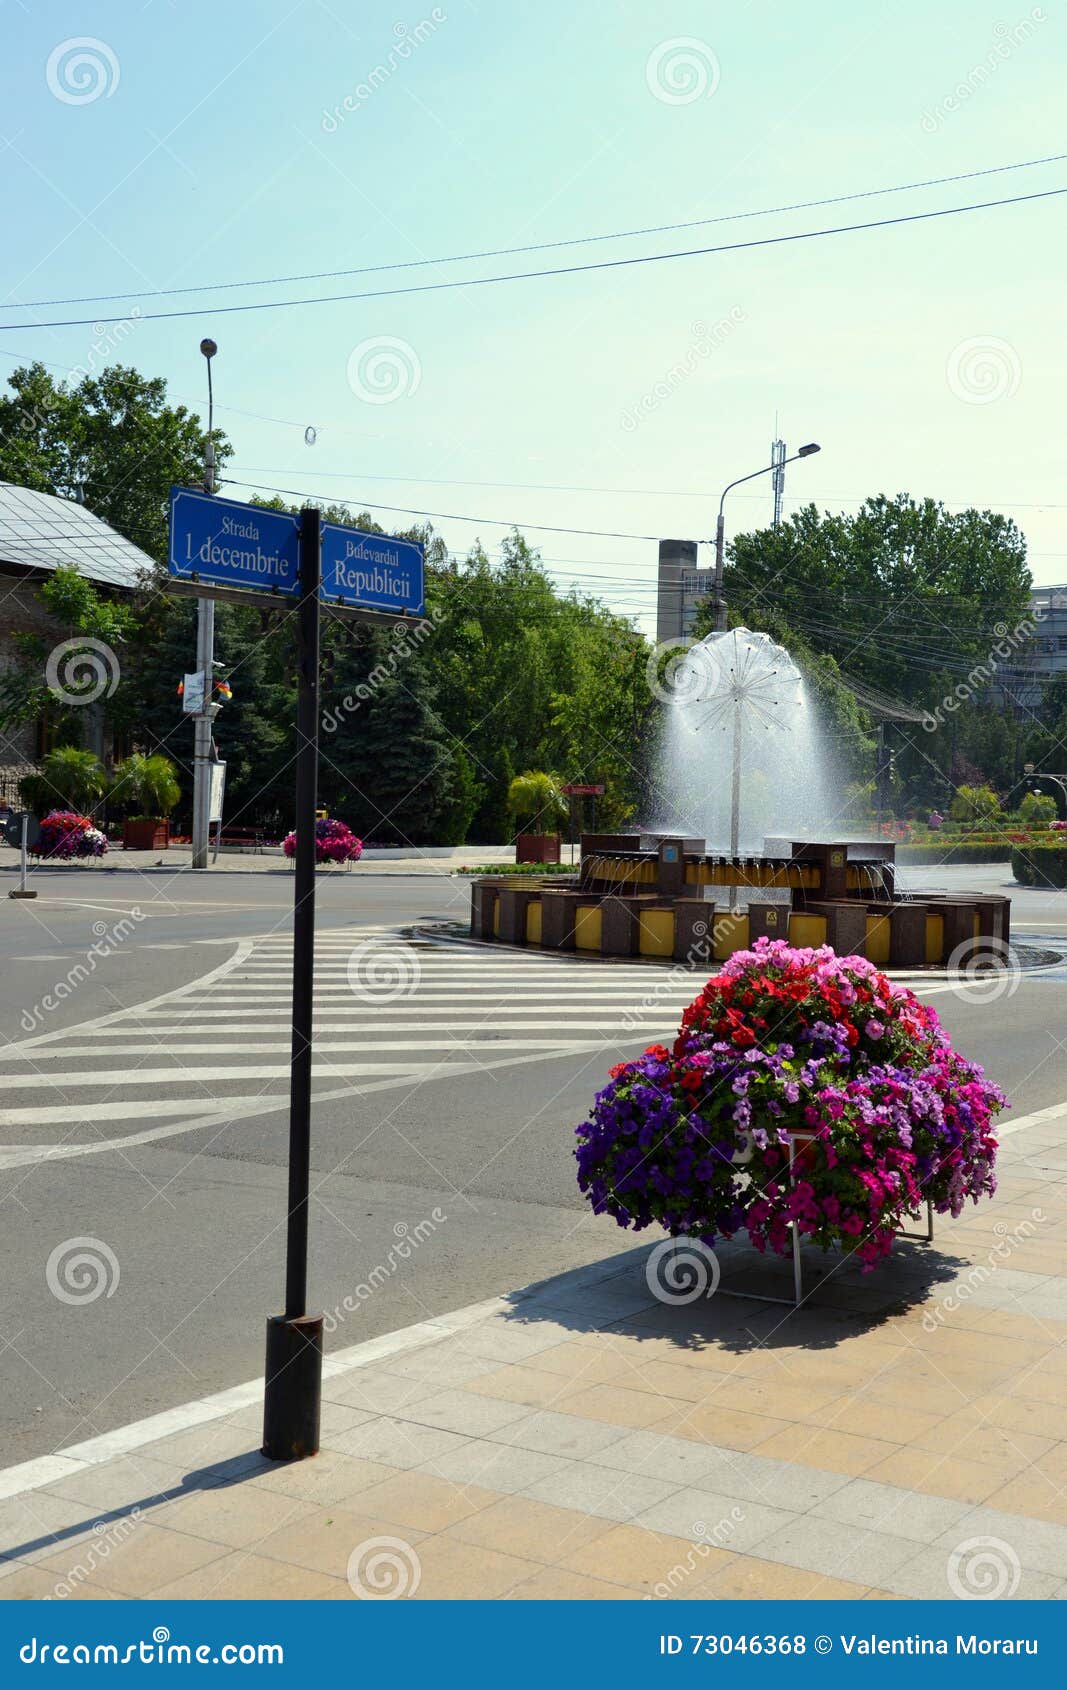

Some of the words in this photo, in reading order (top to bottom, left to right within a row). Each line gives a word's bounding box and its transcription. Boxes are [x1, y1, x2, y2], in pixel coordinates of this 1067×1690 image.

[221, 515, 260, 542] Strada
[186, 533, 192, 560] 1
[200, 540, 289, 577] decembrie
[346, 540, 399, 567] Bulevardul
[334, 560, 411, 599] Republicii
